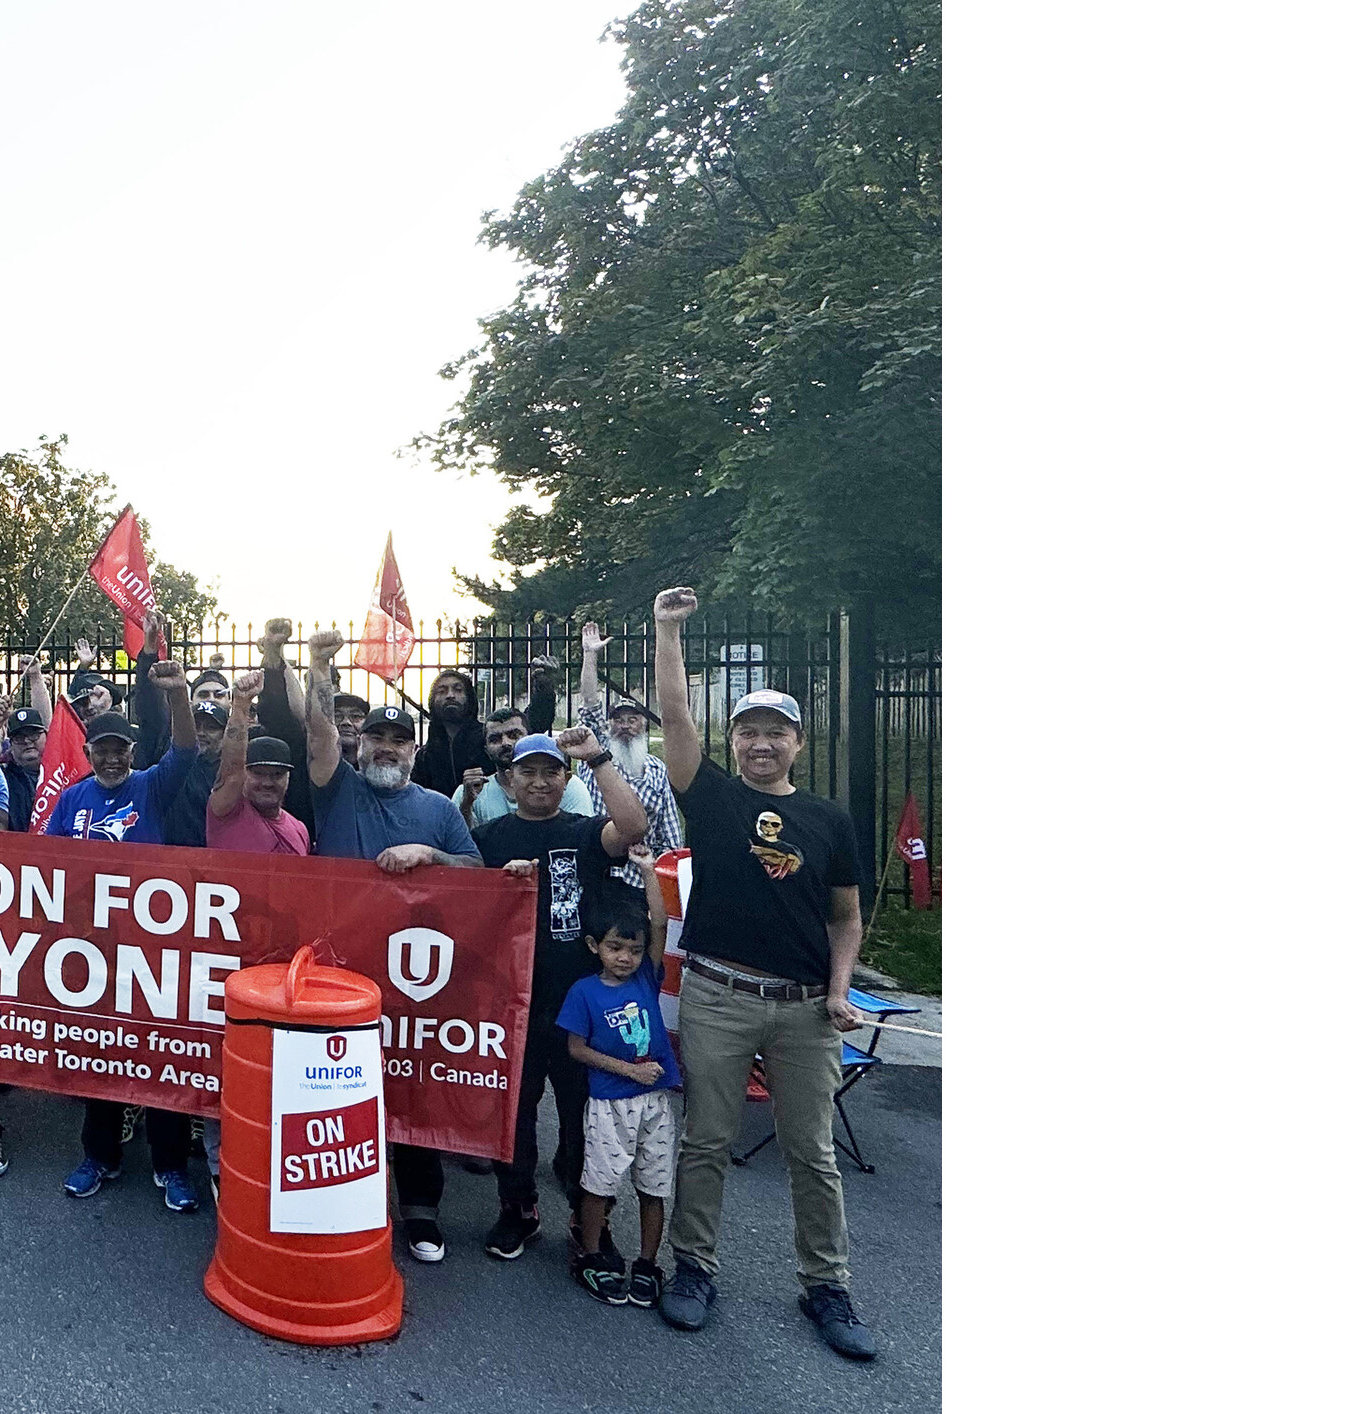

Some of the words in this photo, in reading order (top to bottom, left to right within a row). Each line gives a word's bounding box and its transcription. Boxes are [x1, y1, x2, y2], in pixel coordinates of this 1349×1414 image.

[93, 873, 241, 942] FOR
[53, 1022, 139, 1049] people
[147, 1031, 211, 1058] from
[55, 1049, 152, 1080] Toronto
[430, 1062, 508, 1090] Canada
[306, 1115, 345, 1147] ON
[285, 1139, 376, 1183] STRIKE
